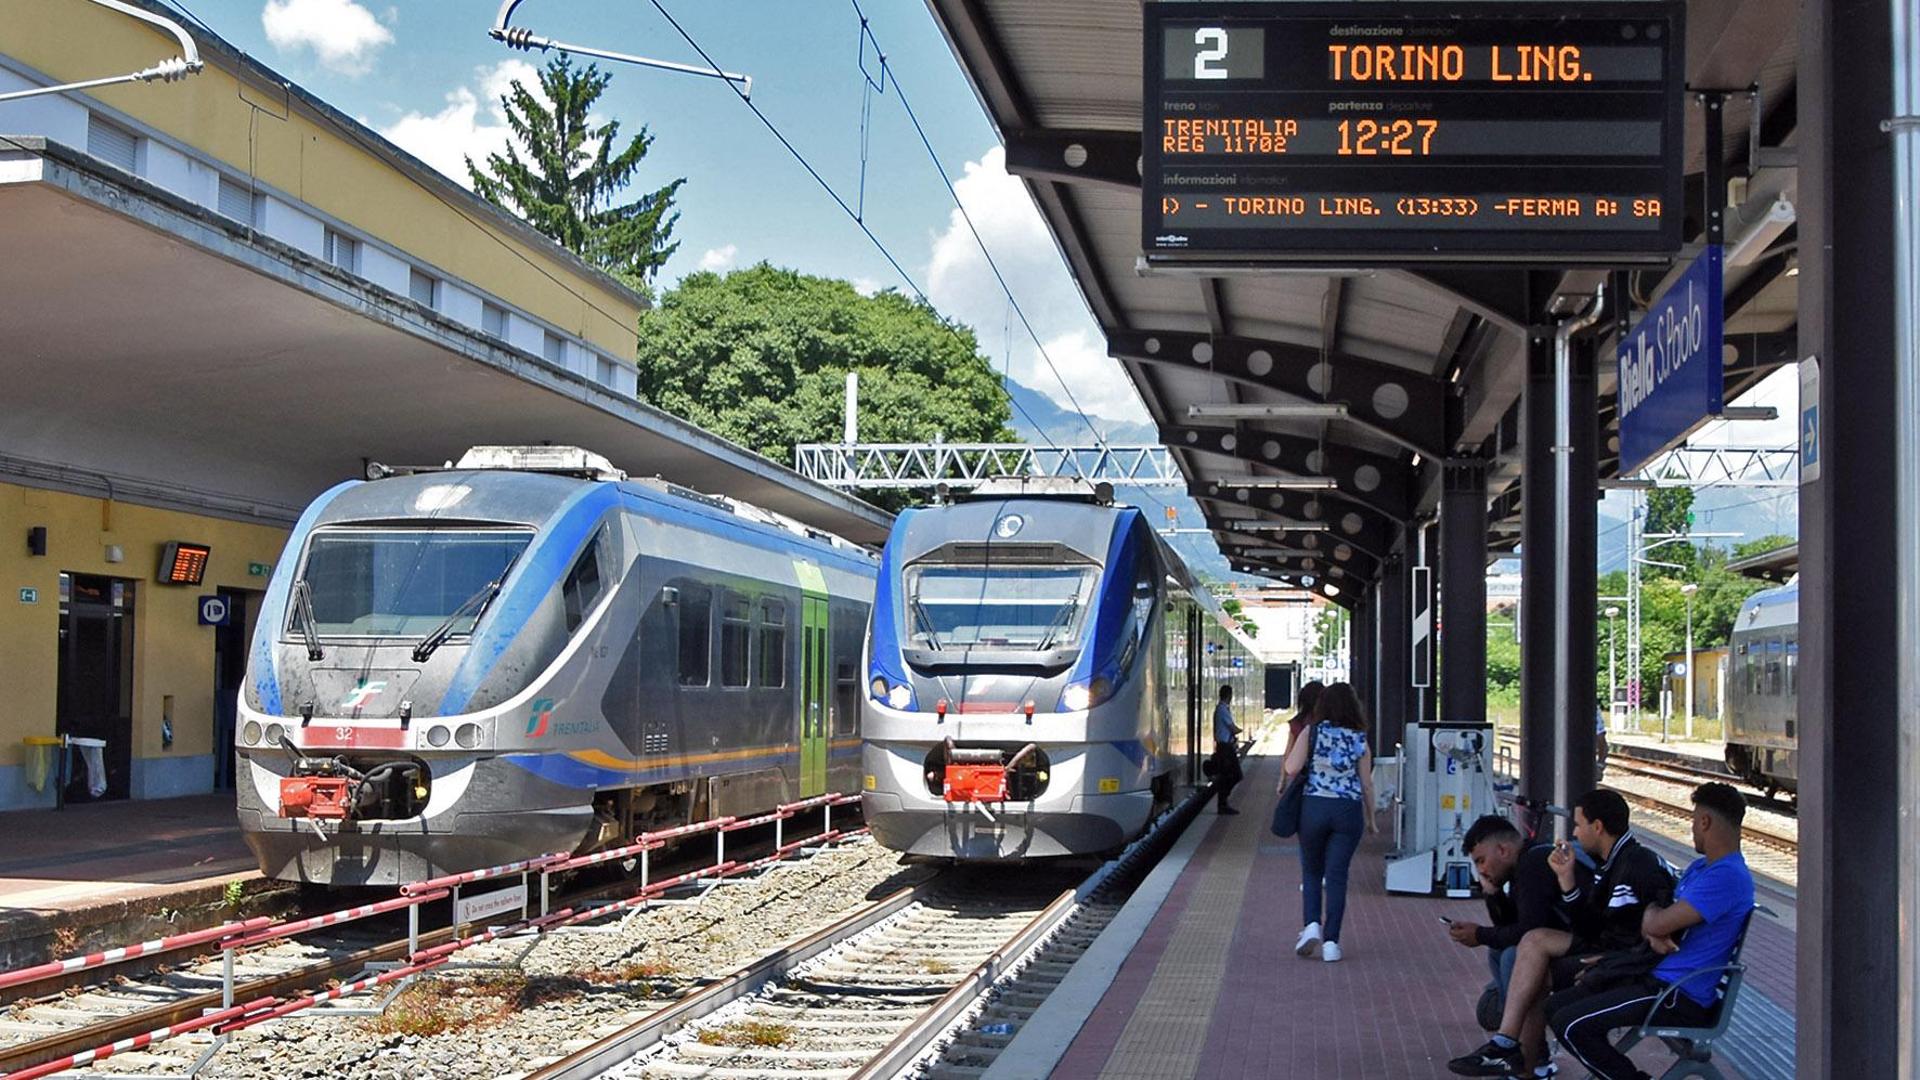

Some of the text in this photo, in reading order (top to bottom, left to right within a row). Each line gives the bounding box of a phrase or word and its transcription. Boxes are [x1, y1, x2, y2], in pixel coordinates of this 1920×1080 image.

[1329, 24, 1404, 36] destinazione
[1195, 28, 1227, 79] 2
[1329, 46, 1591, 80] TORINO LING.
[1164, 101, 1196, 111] treno
[1328, 100, 1384, 113] partenza
[1165, 120, 1296, 136] TRENITALIA
[1164, 136, 1286, 152] REG 11702
[1338, 120, 1437, 154] 12:27
[1163, 173, 1237, 185] informazioni
[1224, 198, 1304, 214] TORINO
[1321, 199, 1380, 214] LING.
[1397, 199, 1477, 215] (13:33)
[1596, 200, 1616, 216] A:
[1634, 200, 1660, 216] SA
[1620, 329, 1655, 418] Biella
[336, 727, 352, 741] 32
